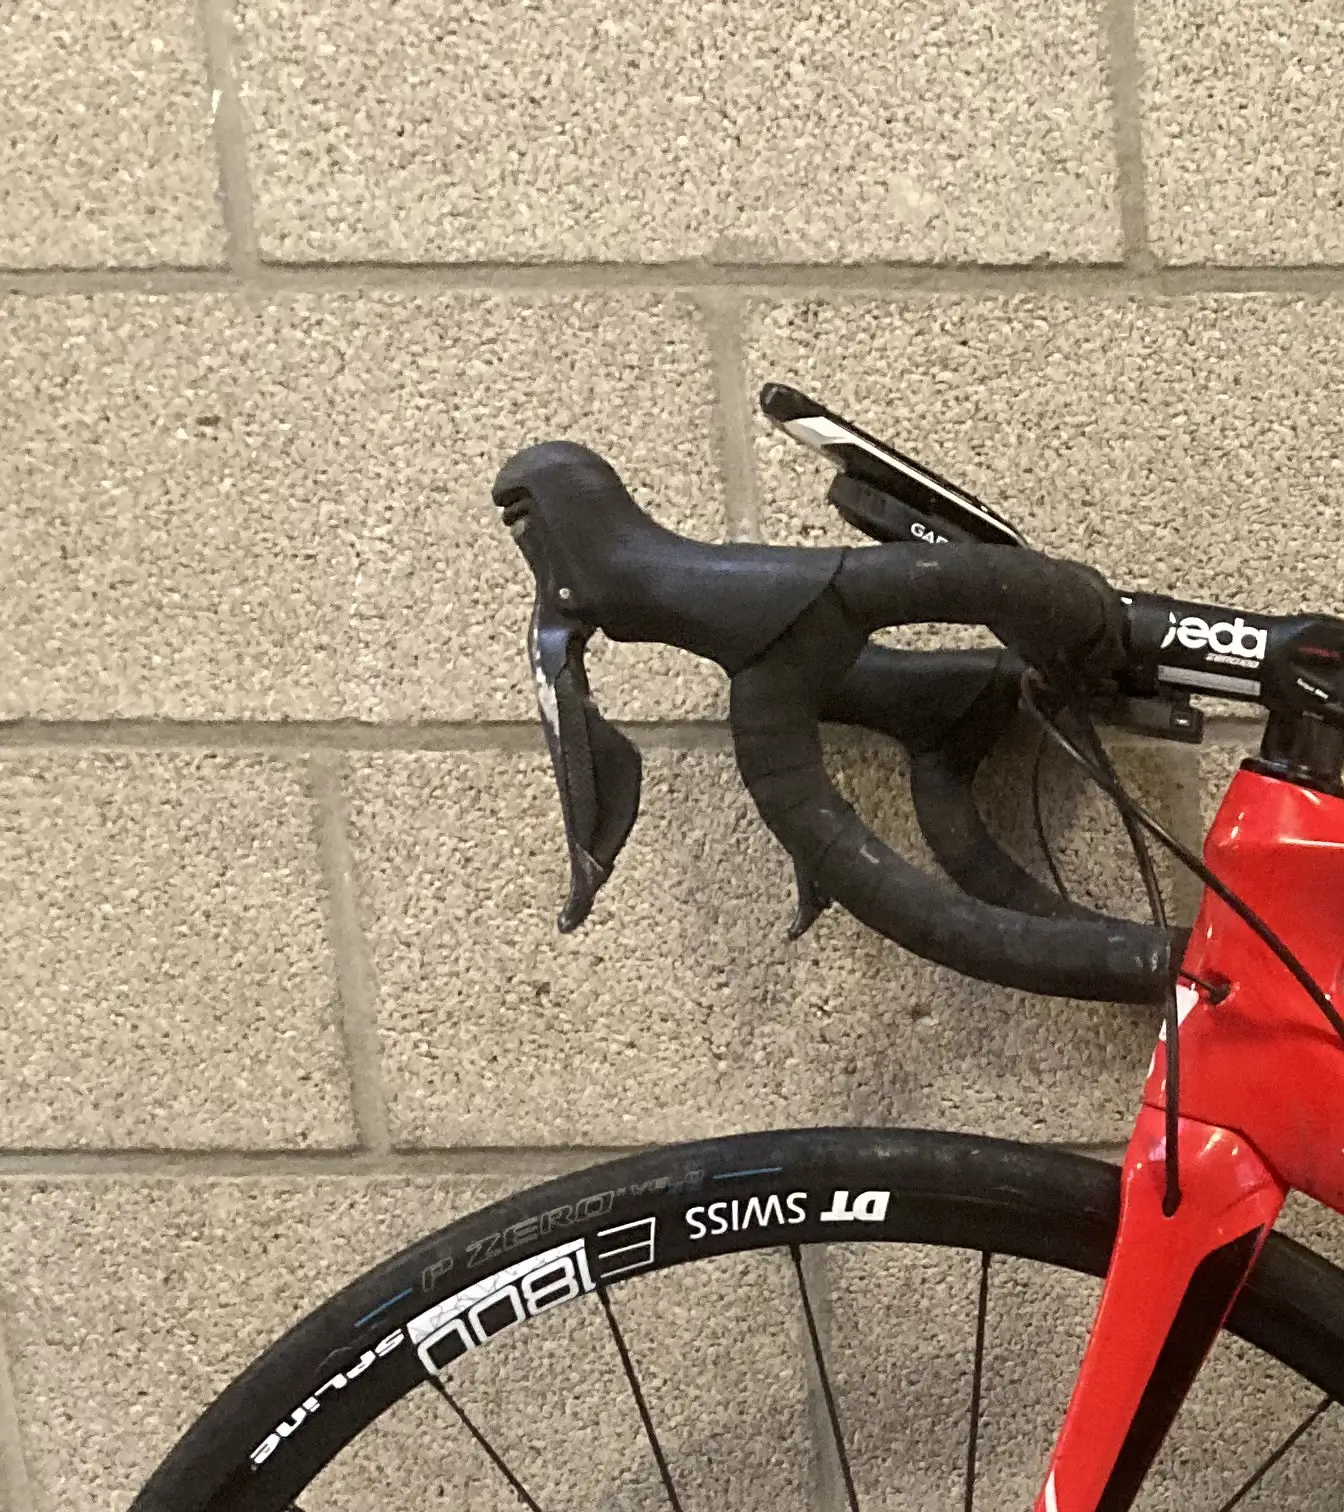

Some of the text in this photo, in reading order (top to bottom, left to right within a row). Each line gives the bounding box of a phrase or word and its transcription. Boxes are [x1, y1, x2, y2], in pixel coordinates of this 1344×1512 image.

[686, 1192, 807, 1240] SWISS
[820, 1191, 891, 1222] DT
[414, 1246, 597, 1377] 1800
